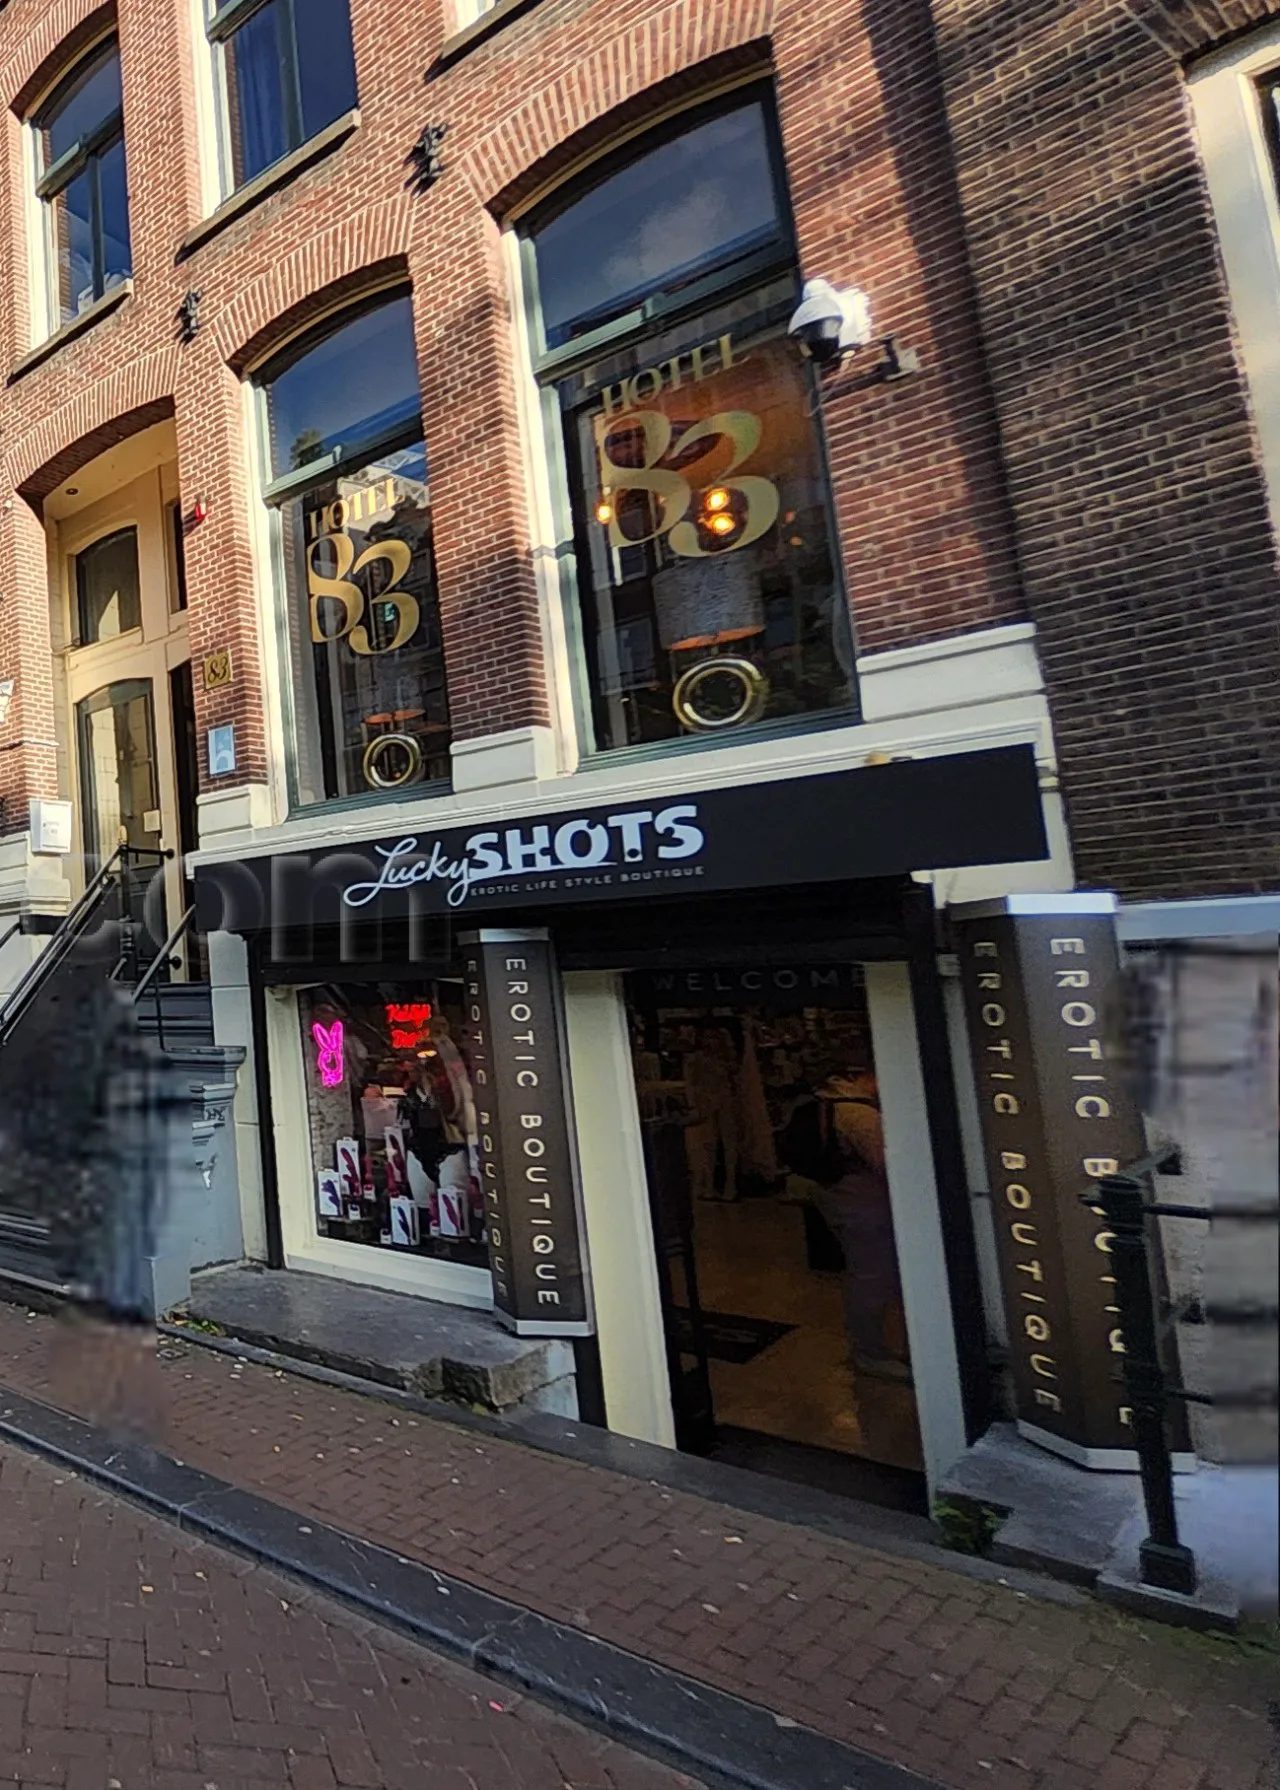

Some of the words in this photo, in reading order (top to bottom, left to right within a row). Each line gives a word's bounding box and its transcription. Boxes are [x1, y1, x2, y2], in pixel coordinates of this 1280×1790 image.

[602, 332, 750, 417] HOTEL
[310, 478, 405, 538] HOTEL
[208, 656, 227, 682] 83
[471, 884, 519, 896] EROTIC
[525, 881, 557, 891] LIFE
[565, 875, 612, 887] STYLE
[620, 866, 705, 882] BOUTIQUE
[467, 960, 487, 1085] EROTIC
[505, 958, 539, 1088] EROTIC
[1050, 937, 1111, 1119] EROTIC
[520, 1113, 560, 1306] BOUTIQUE
[974, 941, 1019, 1116] EROTIC
[1001, 1150, 1062, 1414] BOUTIQUE
